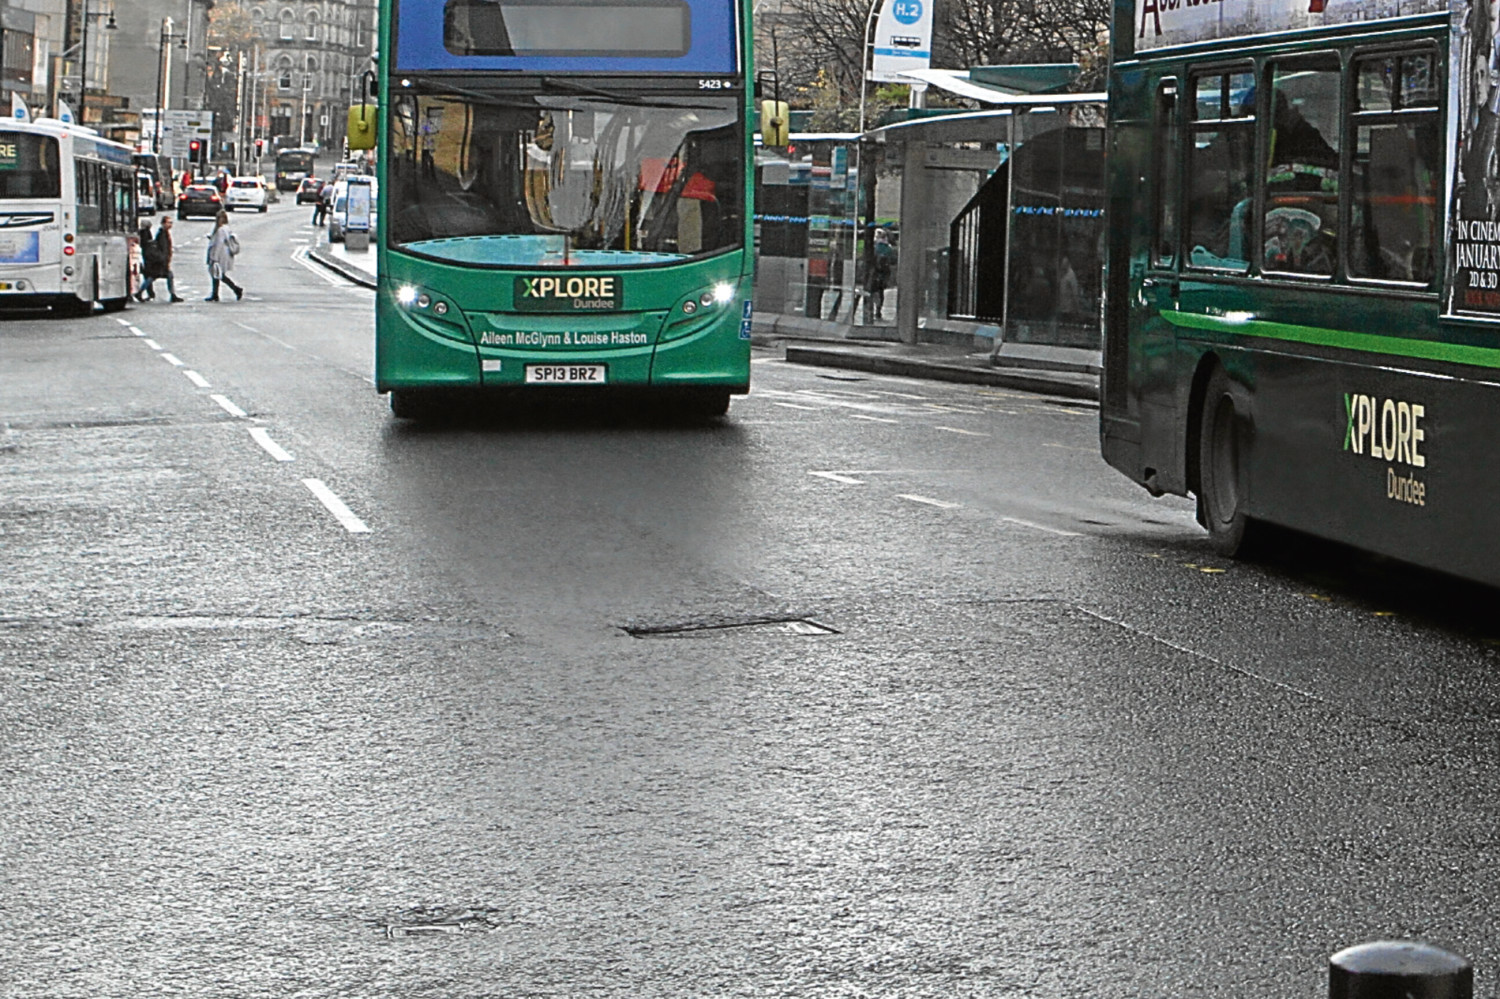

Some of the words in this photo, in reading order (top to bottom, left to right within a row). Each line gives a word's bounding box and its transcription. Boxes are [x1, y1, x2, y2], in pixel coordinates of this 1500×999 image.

[895, 2, 919, 17] H.2
[698, 79, 721, 89] 5423
[1457, 220, 1469, 240] IN
[522, 277, 615, 298] XPLORE
[1469, 270, 1480, 288] 2D
[1480, 271, 1486, 289] &
[1487, 271, 1498, 289] 3D
[573, 298, 614, 309] Dundee
[480, 331, 513, 345] Aileen
[515, 331, 561, 348] McGlynn
[563, 332, 572, 345] &
[574, 331, 609, 345] Louise
[610, 331, 647, 344] Haston
[534, 367, 566, 381] SP13
[569, 367, 597, 381] BRZ
[1343, 392, 1426, 468] XPLORE
[1387, 467, 1426, 507] Dundee
